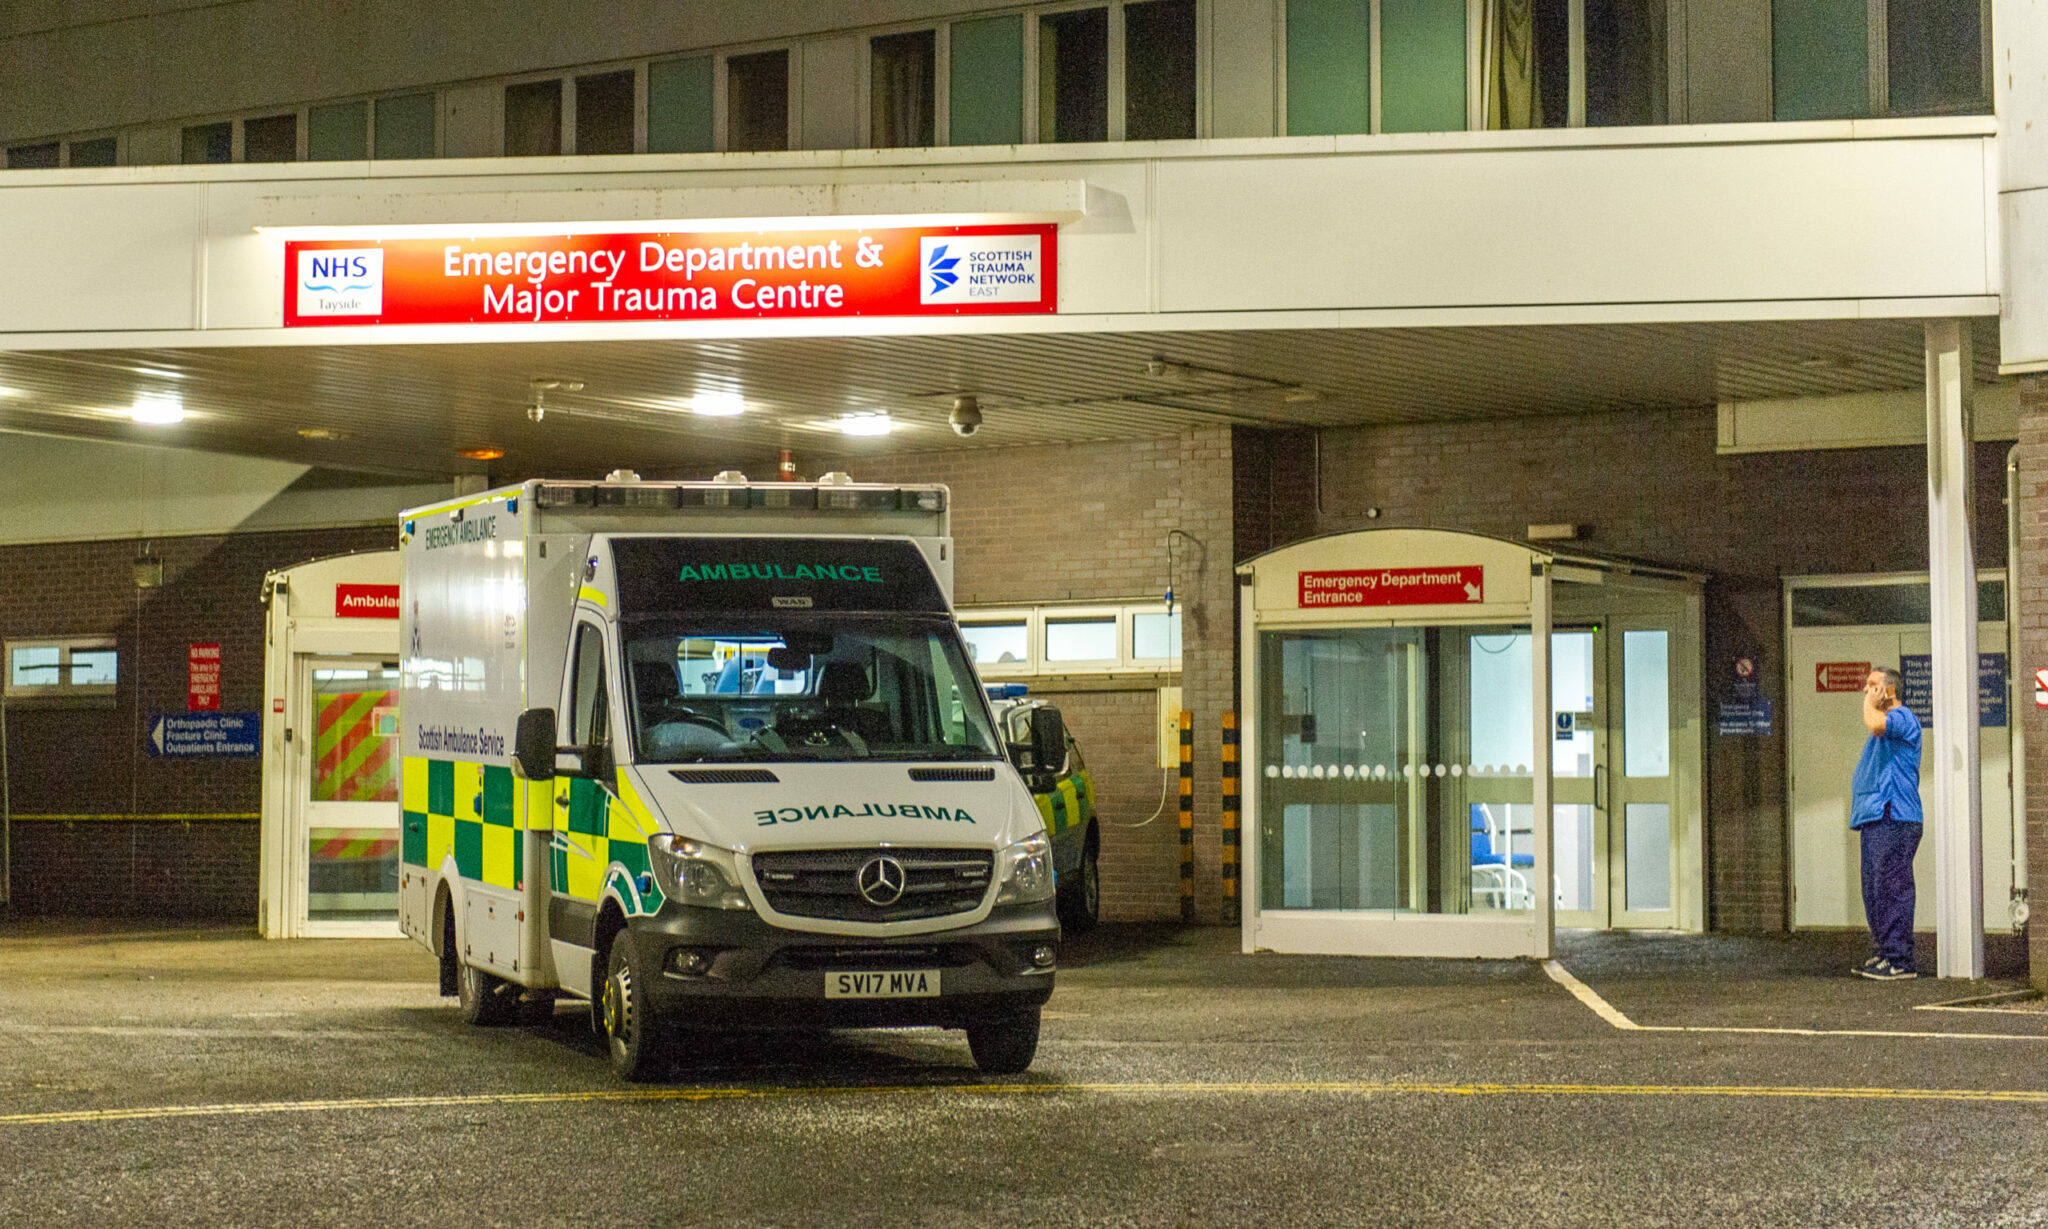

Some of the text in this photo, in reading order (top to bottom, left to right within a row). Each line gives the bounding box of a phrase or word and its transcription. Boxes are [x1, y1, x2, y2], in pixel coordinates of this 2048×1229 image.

[444, 236, 884, 283] Emergency Department &
[969, 251, 1032, 262] SCOTTISH
[312, 256, 367, 278] NHS
[969, 262, 1025, 273] TRAUMA
[969, 273, 1036, 285] NETWORK
[969, 287, 1000, 297] EAST
[318, 298, 362, 312] Tayside
[483, 278, 844, 322] Major Trauma Centre
[426, 515, 496, 551] EMERGENCY AMBULANCE
[679, 563, 884, 583] AMBULANCE
[1303, 571, 1462, 591] Emergency Department
[343, 594, 400, 608] Ambula
[1303, 590, 1363, 604] Entrance
[166, 717, 244, 729] Orthopaedic Clinic
[166, 730, 227, 741] Fracture Clinic
[418, 724, 505, 757] Scottish Ambulance Service
[166, 741, 255, 754] Outpatients Entrance
[838, 972, 928, 994] SV17 MVA
